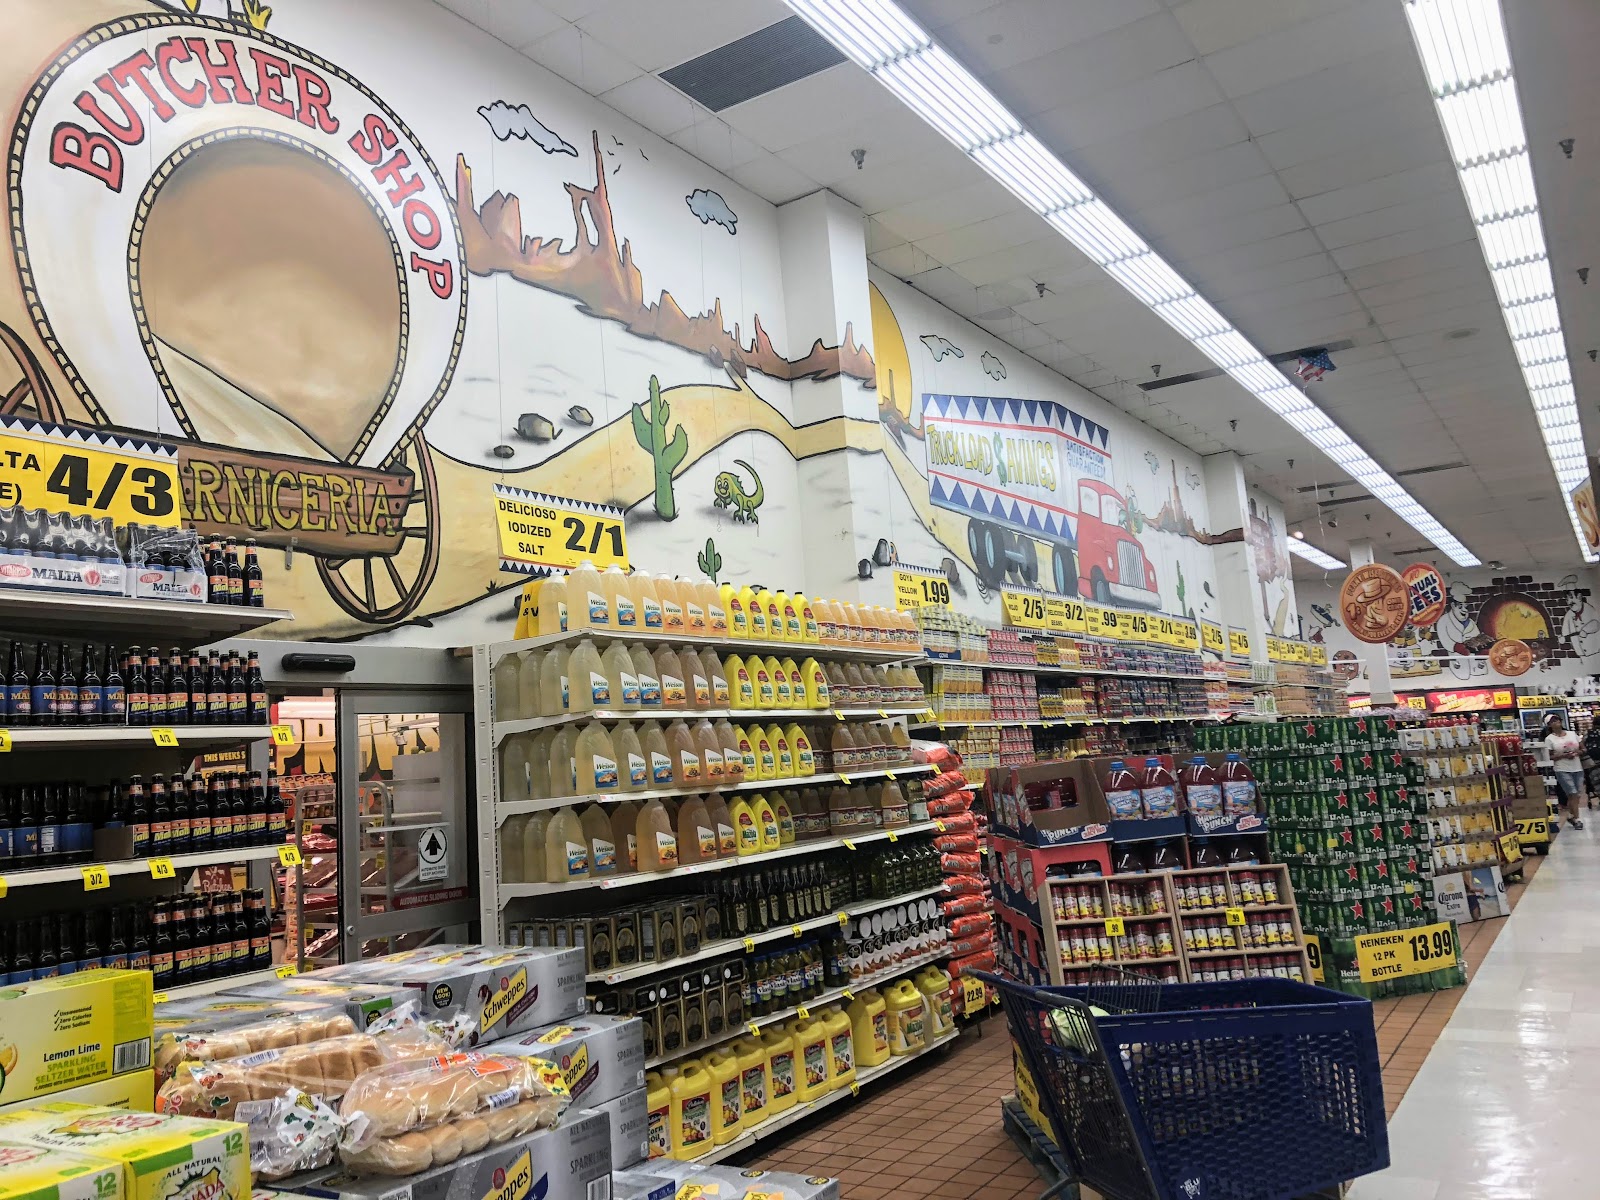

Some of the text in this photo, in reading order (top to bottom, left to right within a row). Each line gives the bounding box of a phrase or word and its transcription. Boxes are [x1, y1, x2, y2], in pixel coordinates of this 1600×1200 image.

[50, 36, 454, 300] BUTCHER SHOP
[46, 453, 174, 517] 4/3
[498, 499, 557, 521] DELICIOSO
[507, 520, 552, 539] IODIZED
[562, 516, 624, 558] 2/1
[518, 542, 545, 557] SALT
[31, 567, 83, 583] MALTA
[899, 573, 913, 582] GOYA
[898, 586, 918, 595] YELLOW
[920, 579, 950, 605] 1.99
[1410, 573, 1438, 598] NUAL
[1023, 597, 1043, 620] 2/5
[1064, 603, 1084, 621] 3/2
[1101, 611, 1117, 628] .99
[1132, 616, 1147, 633] 4/5
[1160, 619, 1173, 635] 2/1
[159, 734, 171, 744] 4/3
[278, 732, 288, 741] 4/3
[204, 754, 218, 763] THIS
[1516, 821, 1546, 835] 2/5
[284, 852, 295, 862] 4/3
[156, 864, 168, 875] 4/3
[90, 873, 103, 886] 3/2
[1438, 890, 1463, 905] Corona
[1360, 934, 1404, 949] HEINEKEN
[1408, 929, 1453, 962] 13.99
[1373, 950, 1396, 961] 12 PK
[1371, 963, 1402, 977] BOTTLE
[483, 977, 525, 1027] Schweppes
[966, 987, 983, 1003] 22.99
[43, 1043, 101, 1063] Lemon Lime
[47, 1054, 97, 1073] SPARKLING
[563, 1055, 586, 1085] eppes
[35, 1061, 106, 1085] SELTZER WATER
[222, 1132, 243, 1152] 12
[166, 1155, 222, 1179] ALL NATURAL
[93, 1172, 117, 1192] 12
[191, 1177, 225, 1200] ADA
